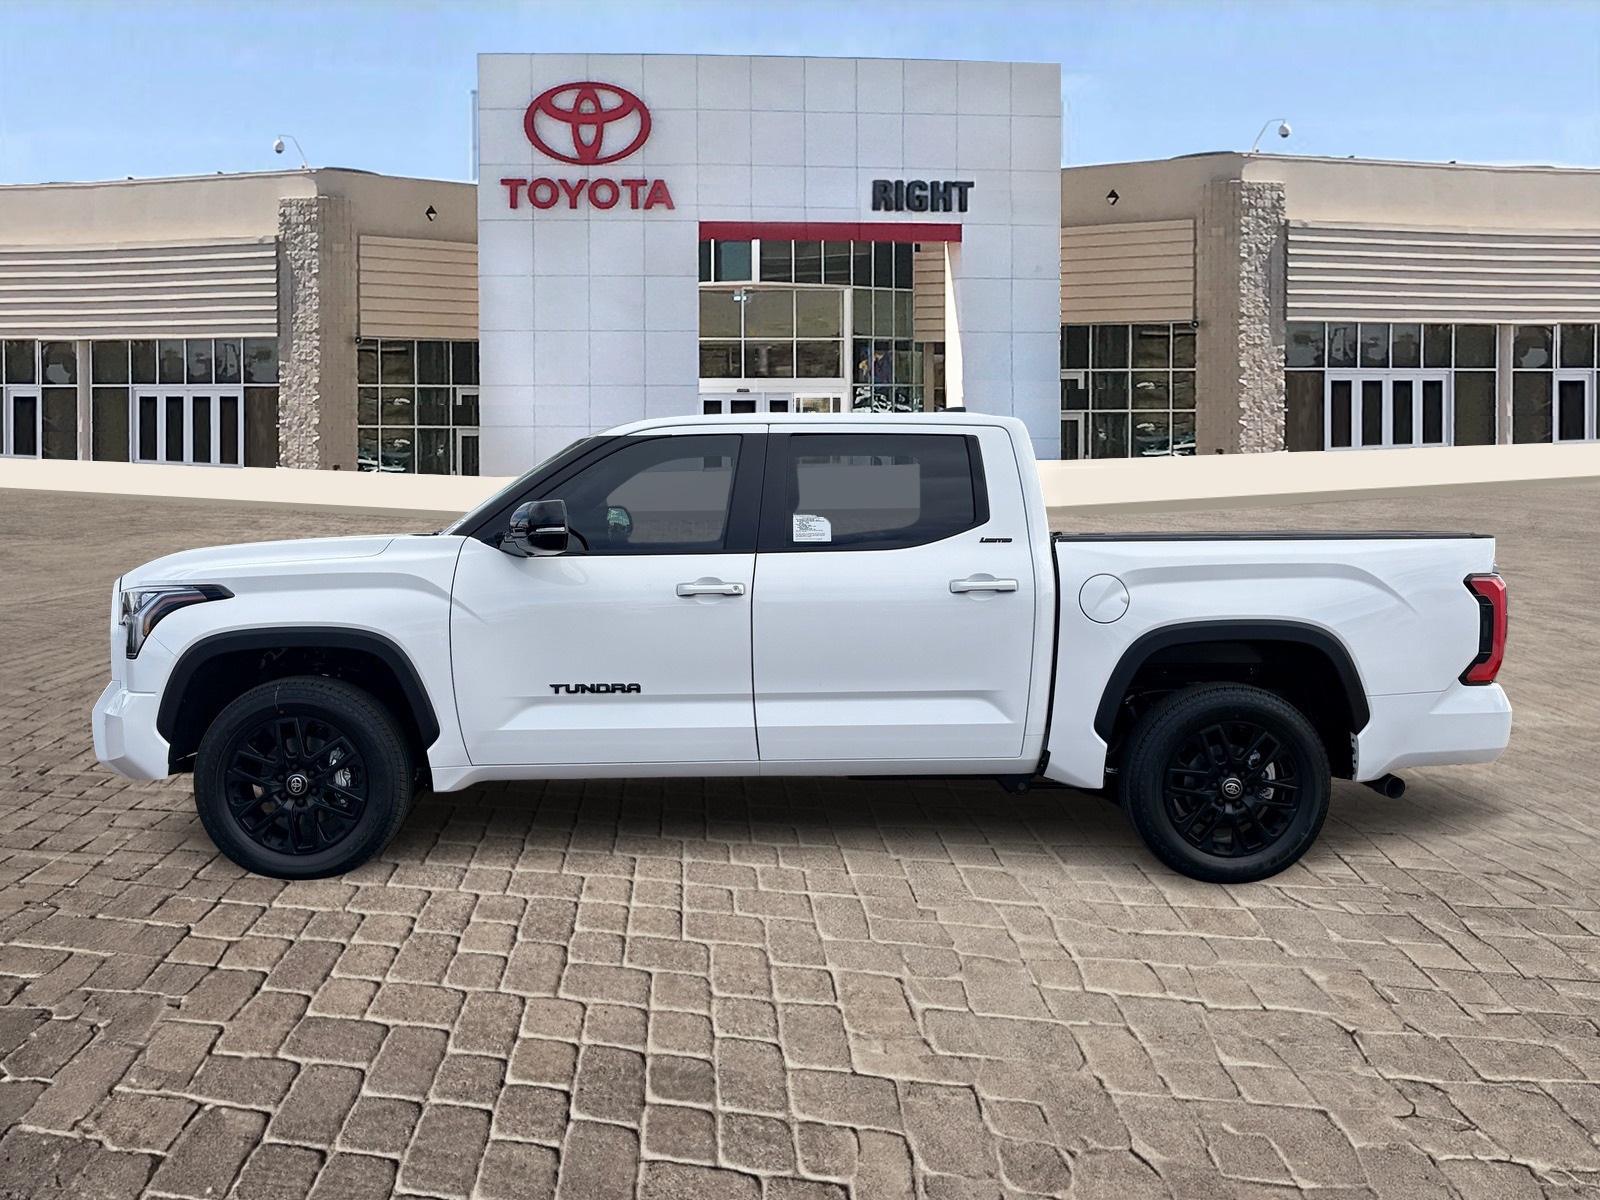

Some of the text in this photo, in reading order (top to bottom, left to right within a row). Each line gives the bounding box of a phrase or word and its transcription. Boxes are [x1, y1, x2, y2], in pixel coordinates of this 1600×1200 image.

[501, 178, 674, 210] TOYOTA
[872, 179, 974, 212] RIGHT
[549, 683, 642, 695] TUNDRA
